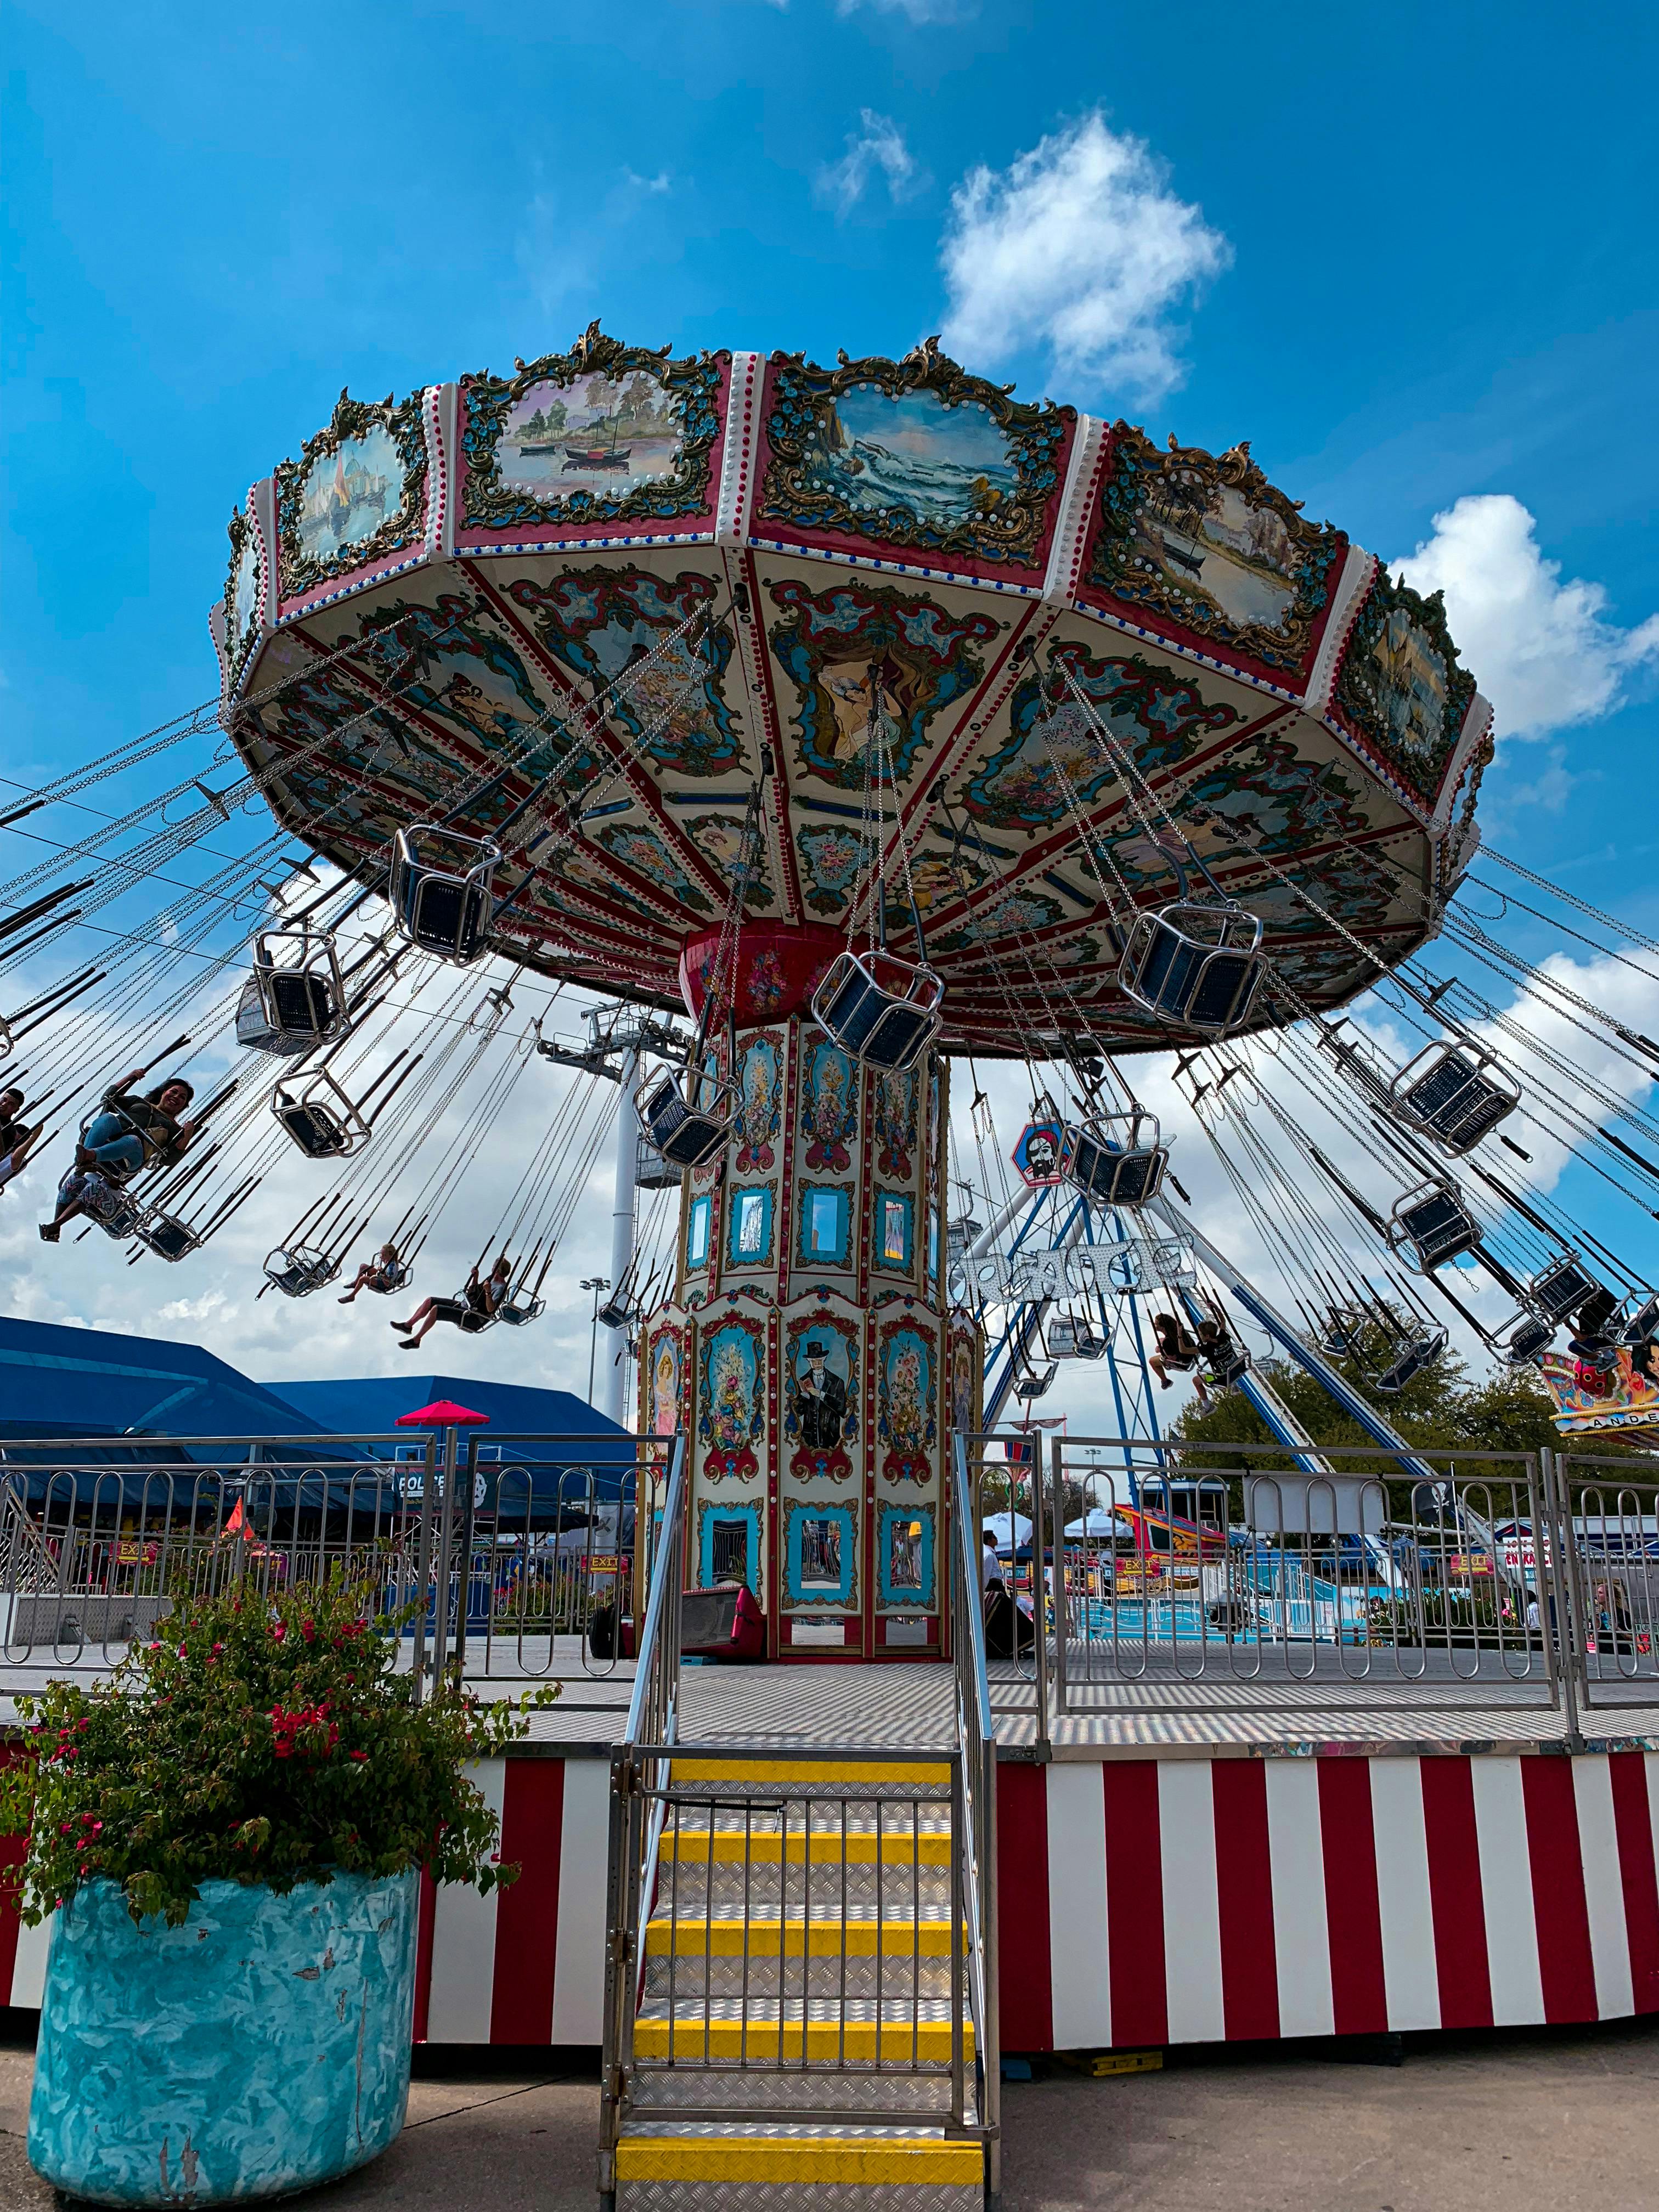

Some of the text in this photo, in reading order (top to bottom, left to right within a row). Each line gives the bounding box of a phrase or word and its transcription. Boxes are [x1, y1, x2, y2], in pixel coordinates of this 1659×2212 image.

[946, 1233, 1197, 1310] RATE
[399, 1475, 444, 1491] POLE
[592, 1557, 619, 1566] EXIT
